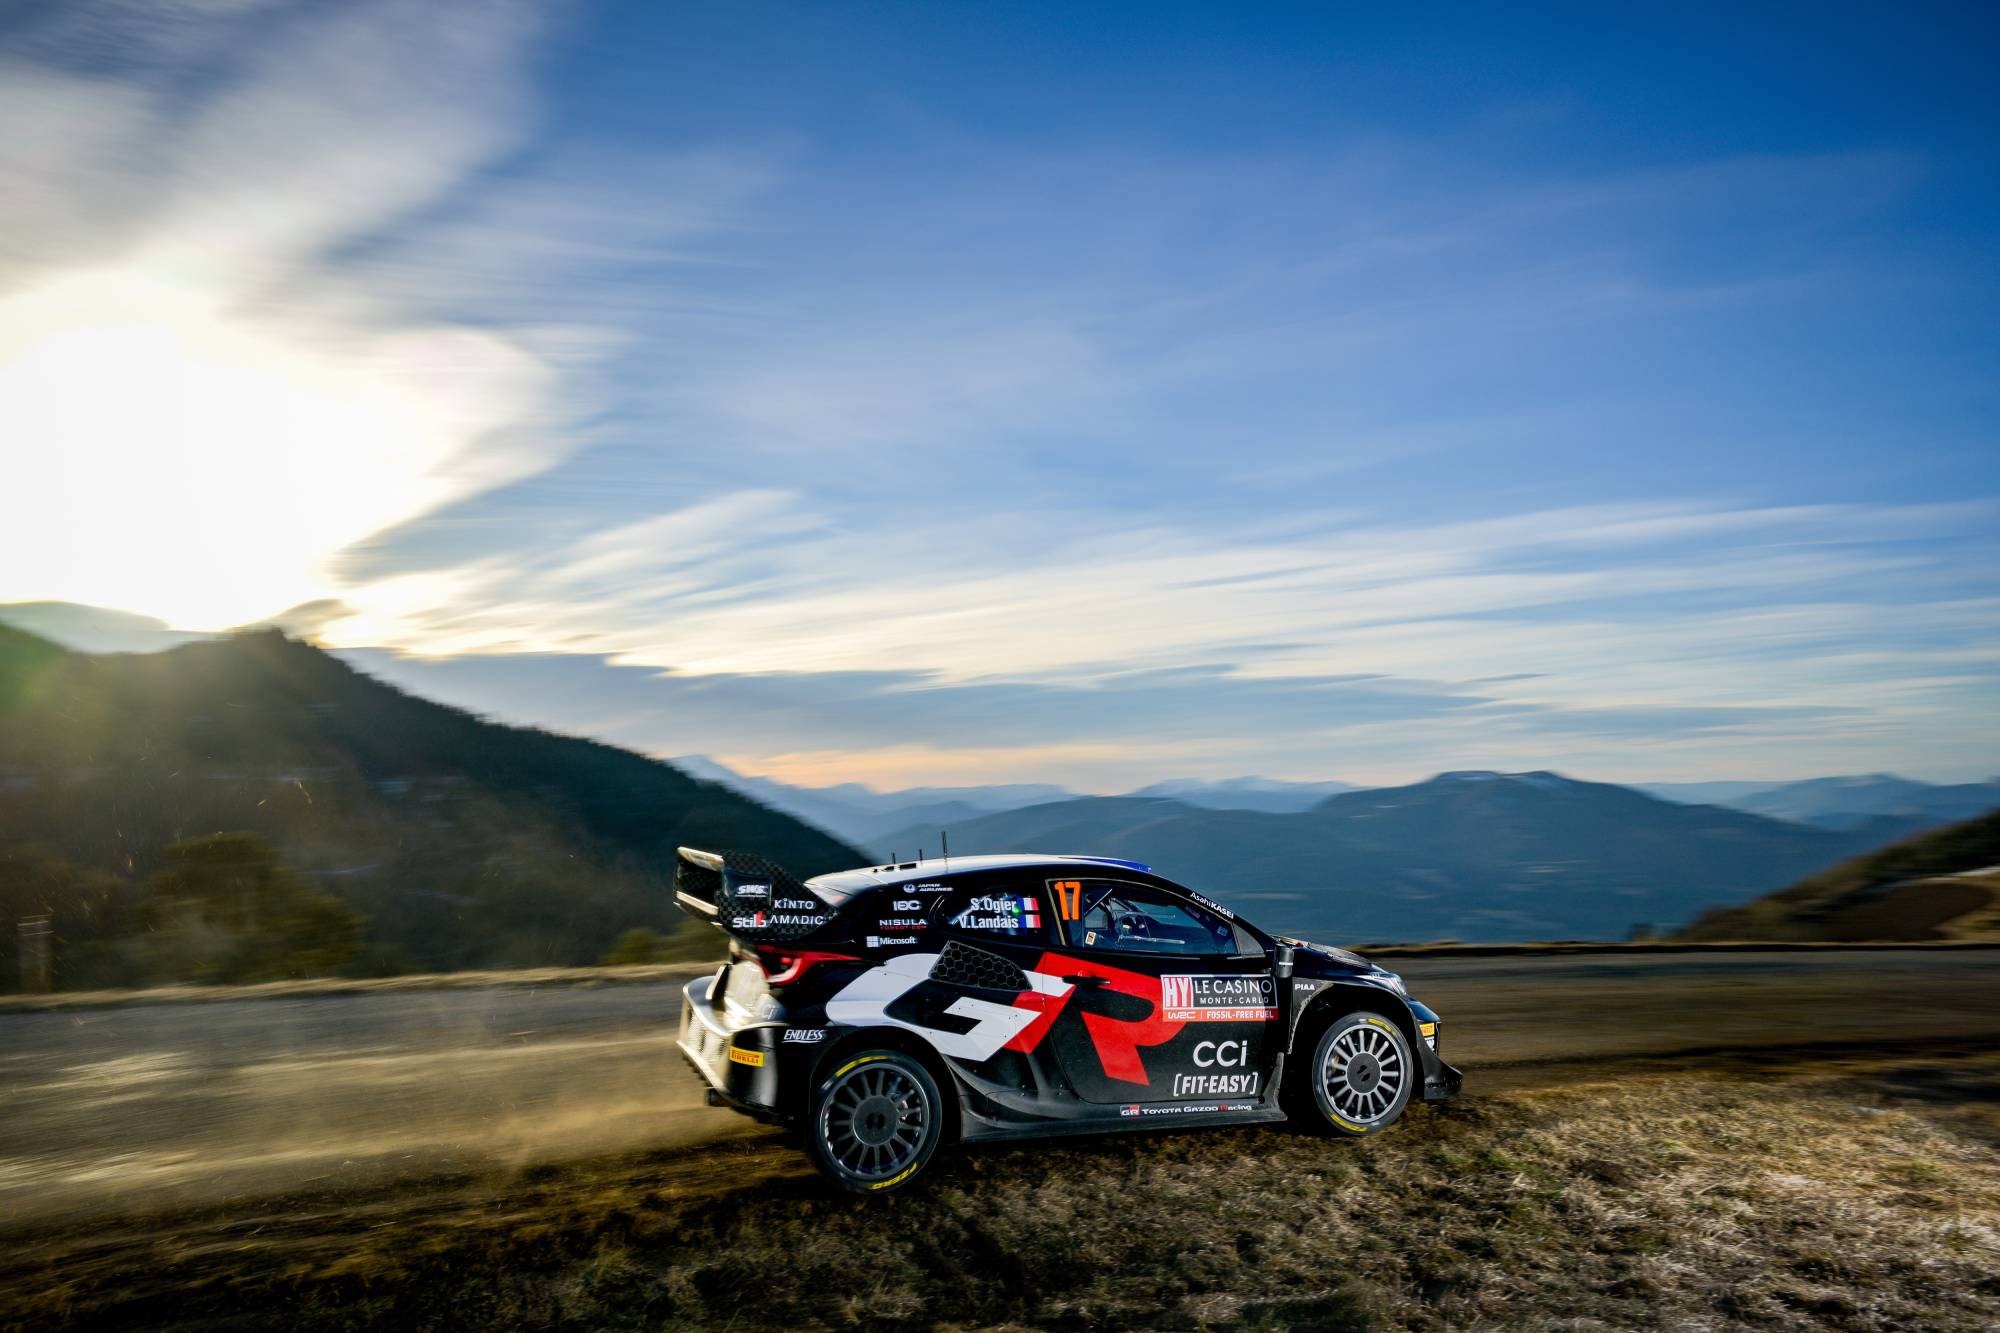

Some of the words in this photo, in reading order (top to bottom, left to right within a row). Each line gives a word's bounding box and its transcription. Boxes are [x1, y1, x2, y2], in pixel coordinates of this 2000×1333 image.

[970, 898, 1017, 914] S.Ogier
[1055, 882, 1080, 920] 17
[960, 915, 1019, 928] V.Landais
[880, 936, 917, 945] Microsoft
[1164, 977, 1189, 1008] HY
[1195, 980, 1209, 994] LE
[1213, 980, 1272, 993] CASINO
[1294, 983, 1315, 991] PIAA
[1206, 1010, 1254, 1019] FOSSIL-FREE
[1255, 1009, 1274, 1018] FUEL
[783, 1030, 825, 1041] ENDLESS
